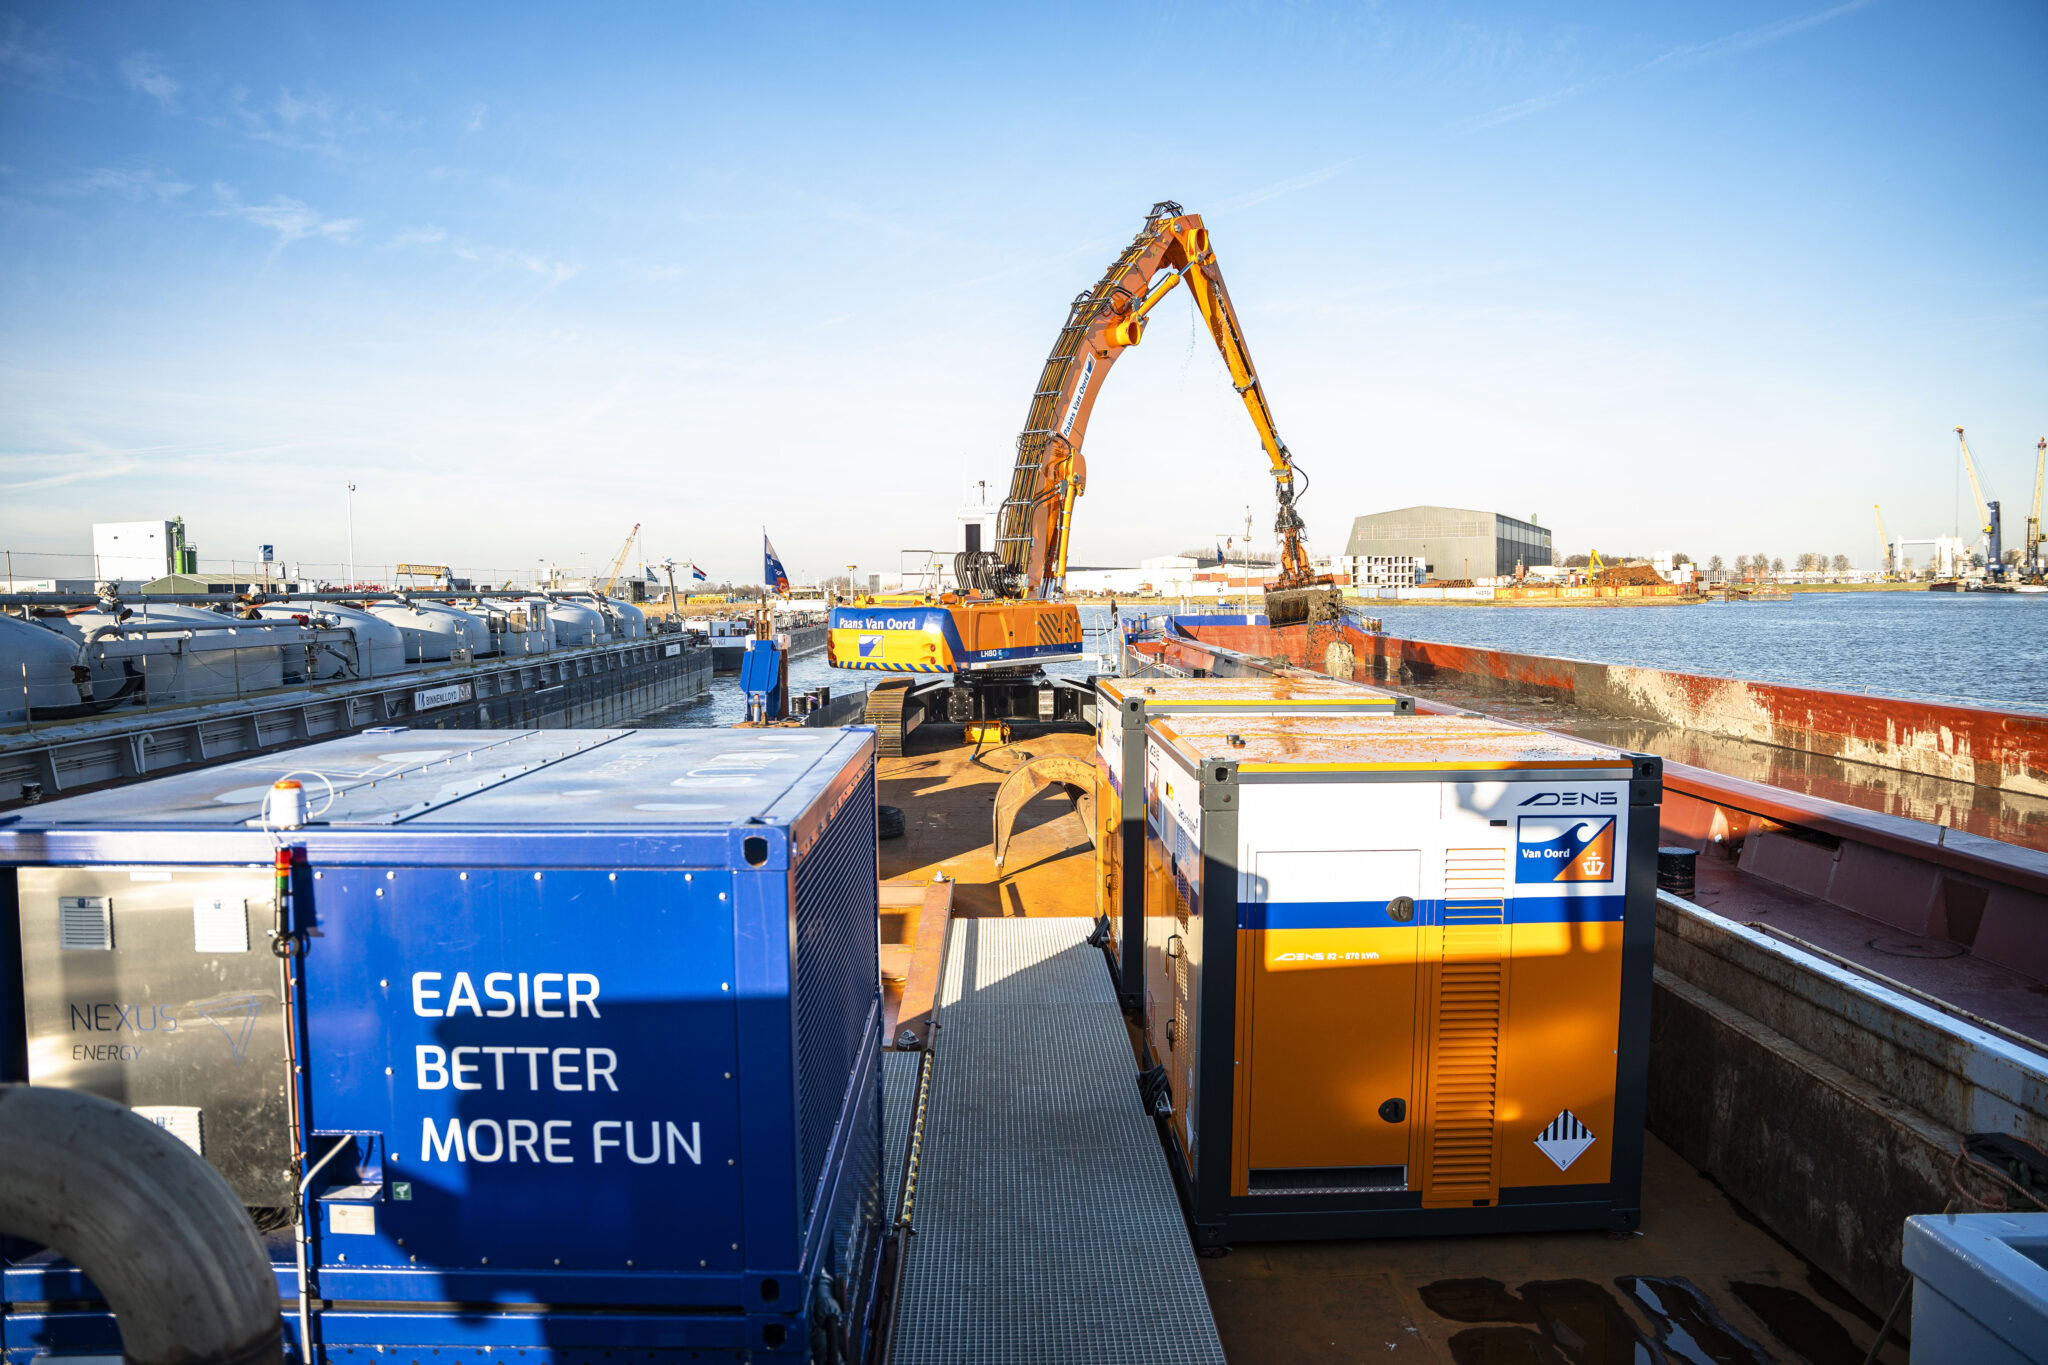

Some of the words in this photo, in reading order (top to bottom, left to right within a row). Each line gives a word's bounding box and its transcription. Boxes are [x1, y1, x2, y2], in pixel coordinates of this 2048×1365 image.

[1063, 412, 1076, 437] Paans
[1072, 395, 1082, 411] Van
[1078, 372, 1090, 395] Oord
[839, 617, 863, 629] Paans
[865, 618, 884, 630] Van
[886, 618, 916, 630] Oord
[980, 649, 997, 658] LH80
[1517, 792, 1618, 807] DENS
[1522, 848, 1541, 858] Van
[1544, 848, 1570, 858] Oord
[1274, 952, 1325, 961] DENS
[1345, 952, 1359, 960] 870
[1361, 951, 1379, 960] kWh
[411, 971, 602, 1019] EASIER
[70, 1003, 177, 1032] NEXUS
[72, 1044, 143, 1061] ENERGY
[415, 1045, 619, 1092] BETTER
[421, 1117, 574, 1163] MORE
[593, 1120, 702, 1165] FUN
